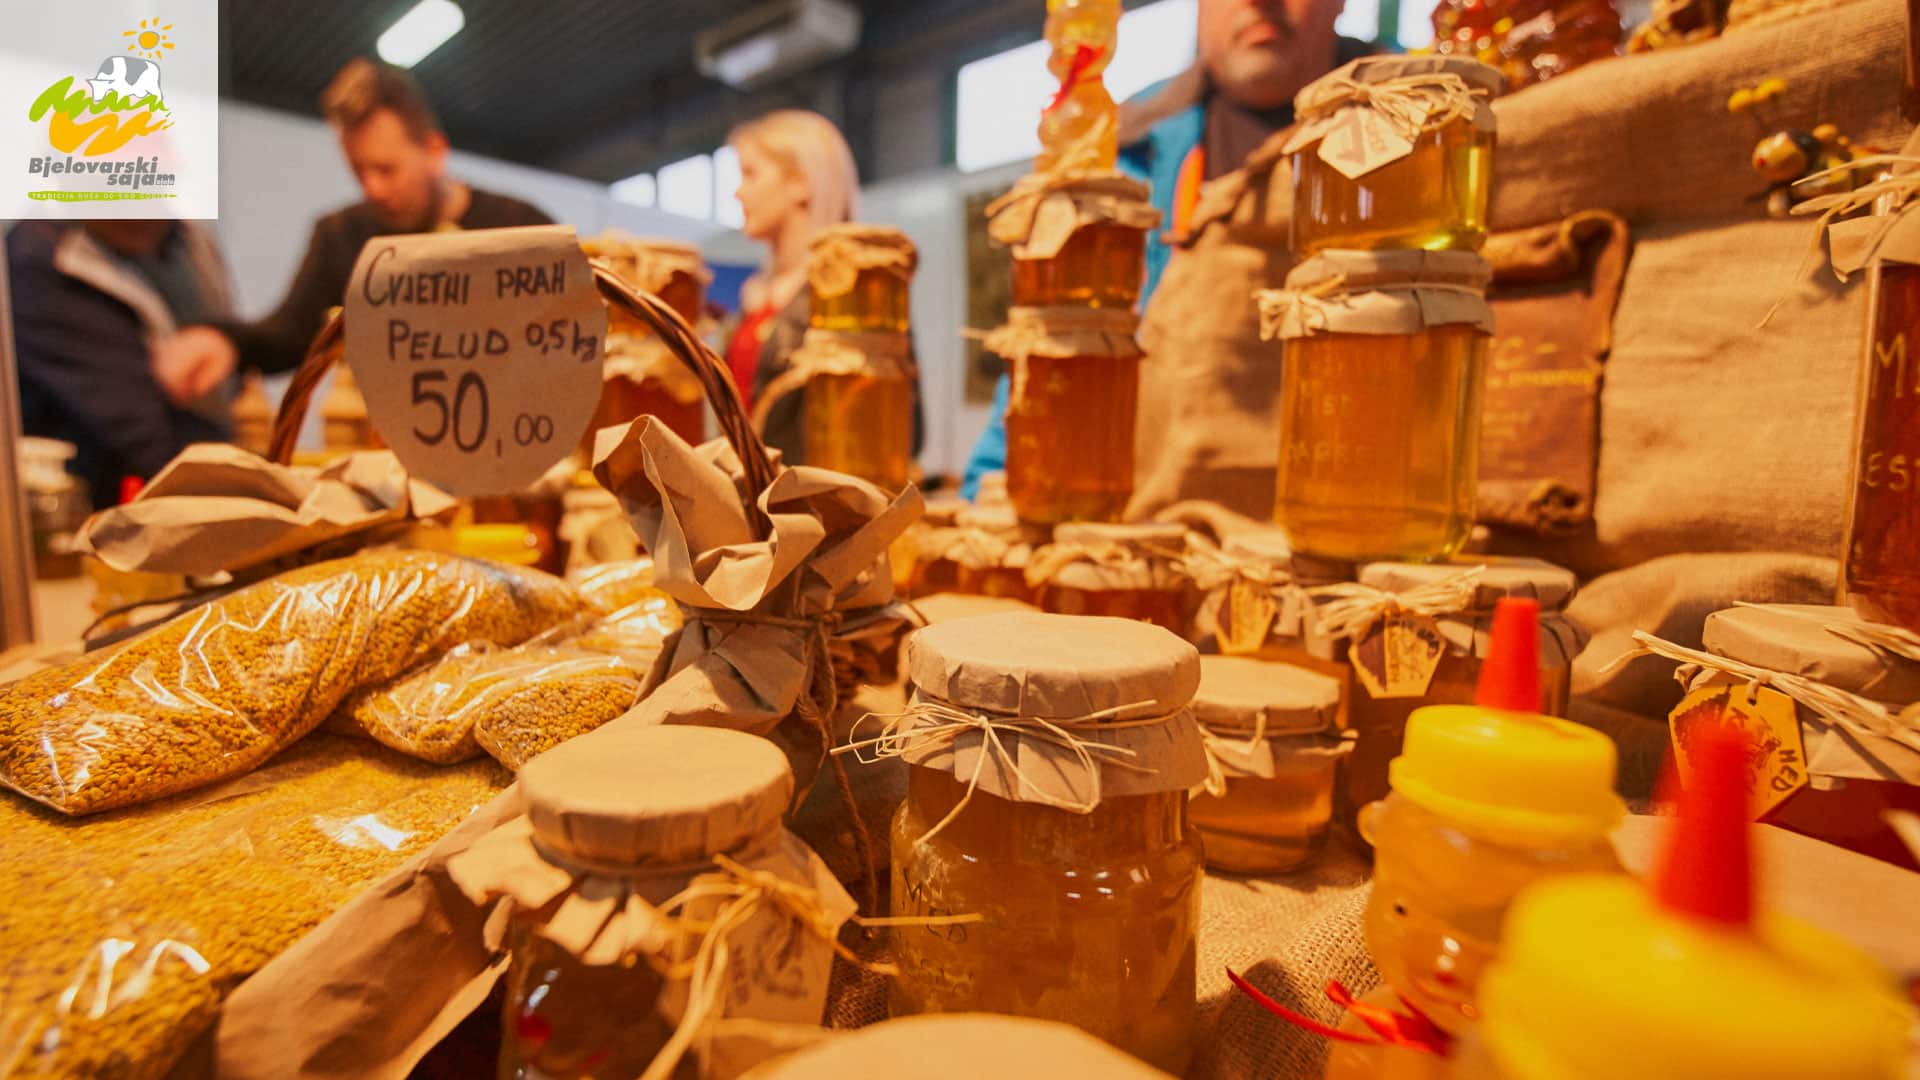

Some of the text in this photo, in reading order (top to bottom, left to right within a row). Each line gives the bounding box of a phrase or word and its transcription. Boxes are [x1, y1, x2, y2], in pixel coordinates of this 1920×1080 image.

[495, 260, 567, 299] PRAH
[387, 318, 510, 361] PELUD
[1872, 331, 1920, 399] M
[411, 369, 555, 458] 50,00
[1771, 748, 1799, 792] MED
